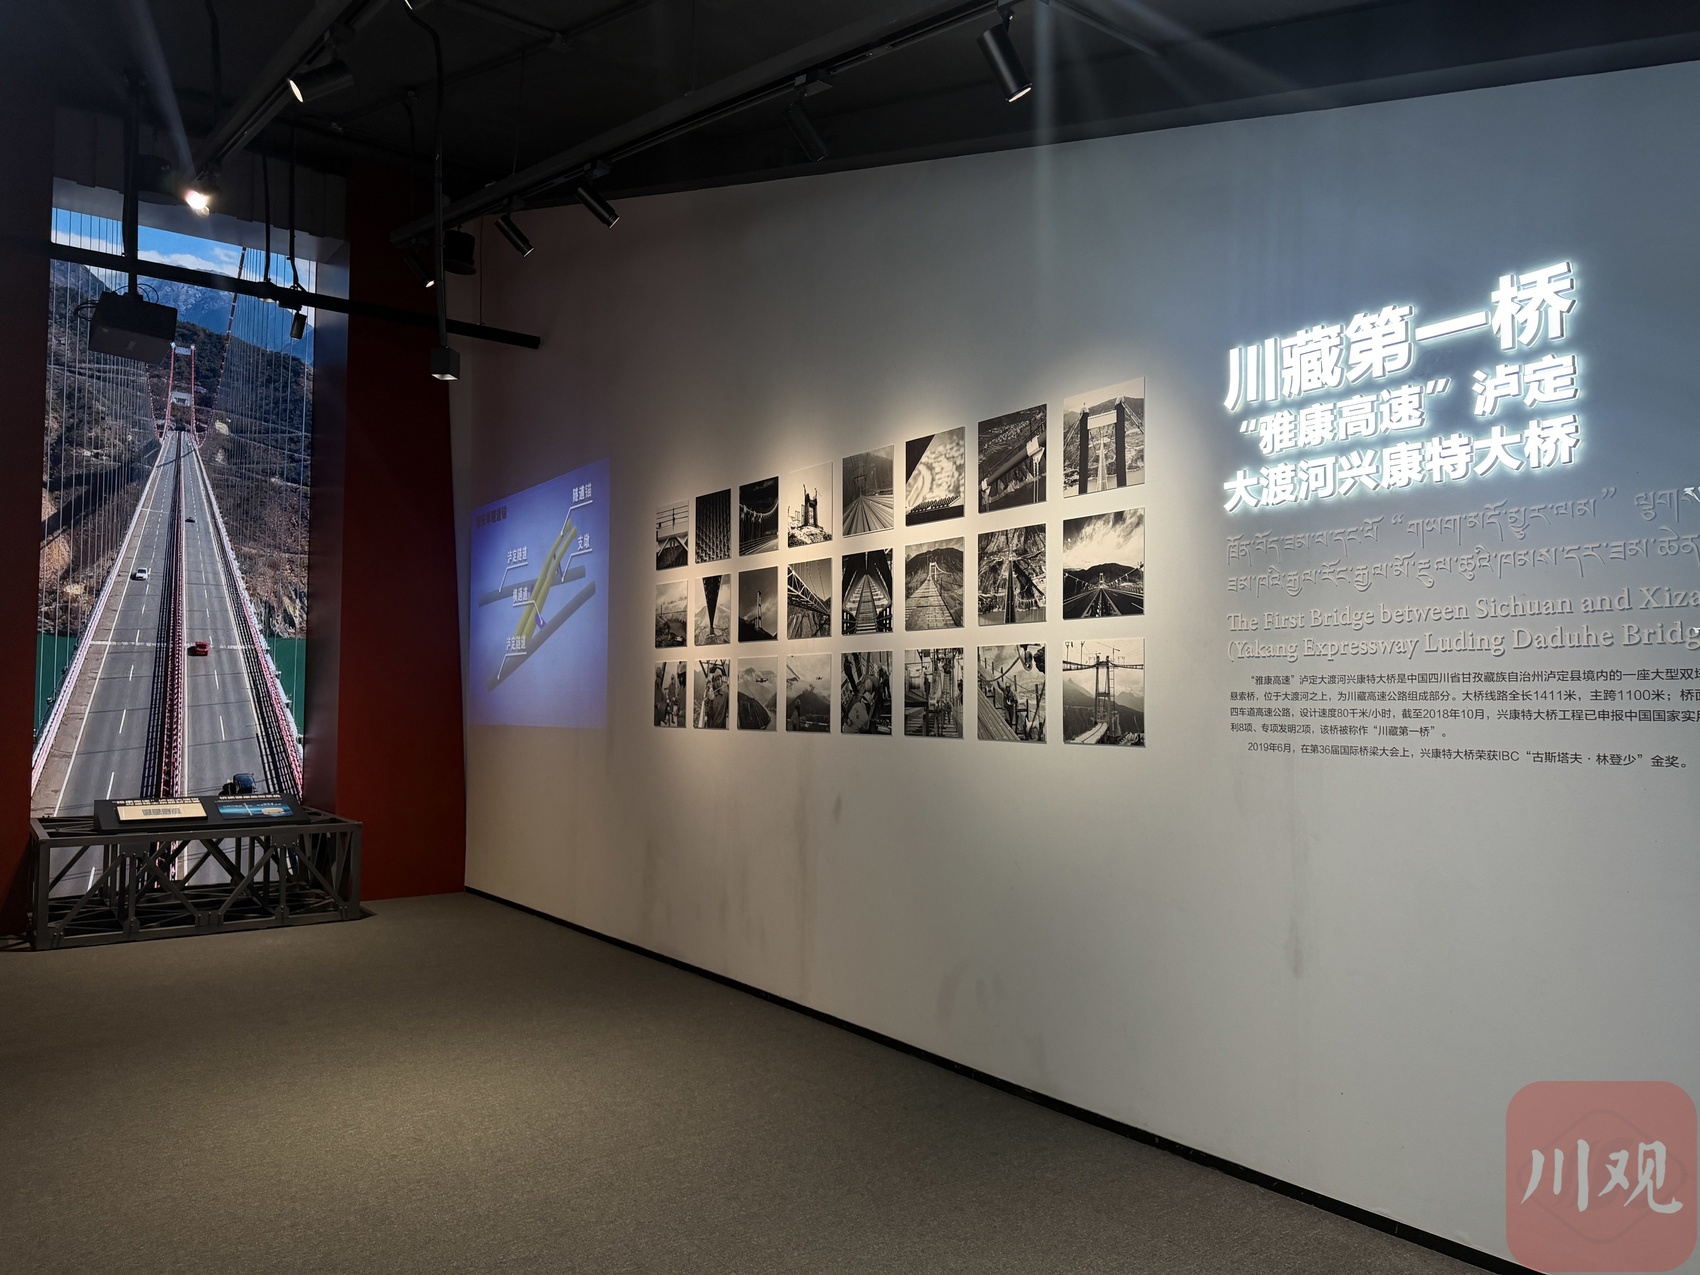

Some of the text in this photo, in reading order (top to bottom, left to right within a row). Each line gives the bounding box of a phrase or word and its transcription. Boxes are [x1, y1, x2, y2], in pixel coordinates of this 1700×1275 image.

[1223, 260, 1577, 411] 川藏第一桥
[1223, 414, 1582, 514] 大渡河兴康特大桥
[1227, 612, 1259, 632] The
[1263, 610, 1305, 631] First
[1309, 607, 1375, 633] Bridge
[1379, 598, 1470, 625] between
[1476, 593, 1574, 619] Sichuan
[1581, 588, 1633, 612] and
[1227, 639, 1299, 663] (Yakang
[1303, 636, 1420, 661] Expressway
[1424, 630, 1506, 657] Luding
[1512, 622, 1615, 650] Daduhe
